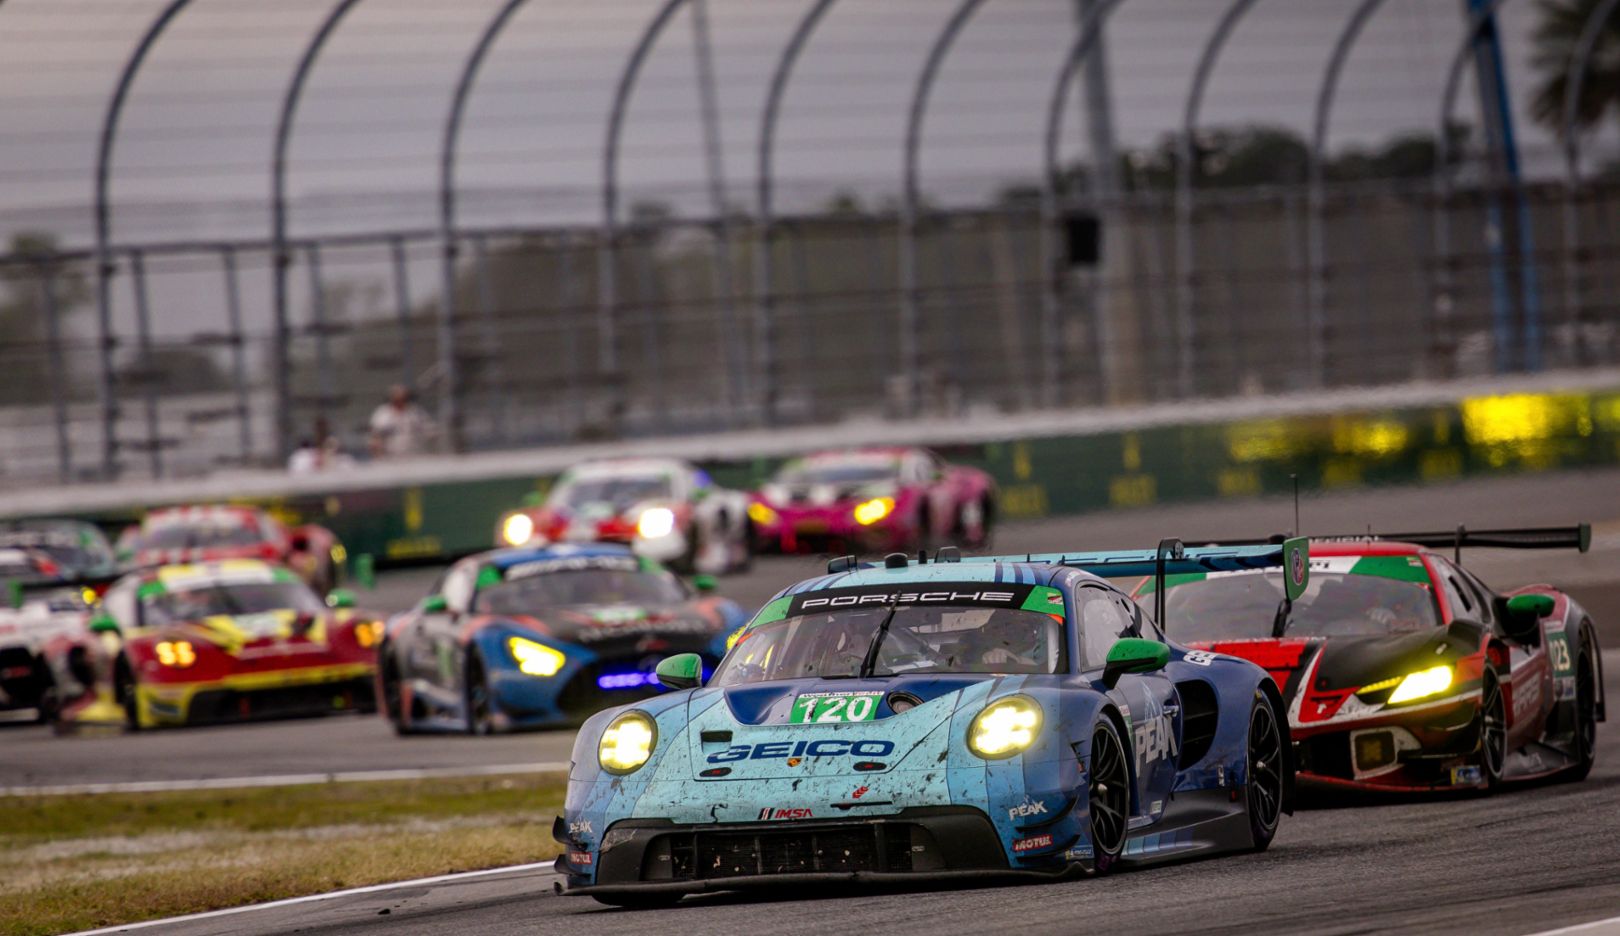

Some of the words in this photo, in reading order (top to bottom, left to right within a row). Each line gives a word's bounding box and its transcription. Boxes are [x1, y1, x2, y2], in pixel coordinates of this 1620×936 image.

[802, 591, 1014, 609] PORSCHE
[799, 696, 873, 724] 120
[707, 739, 895, 764] GEICO
[1135, 714, 1178, 779] PEAK
[775, 808, 813, 819] IMSA
[1008, 800, 1048, 821] PEAK
[1015, 836, 1052, 851] MOTUL
